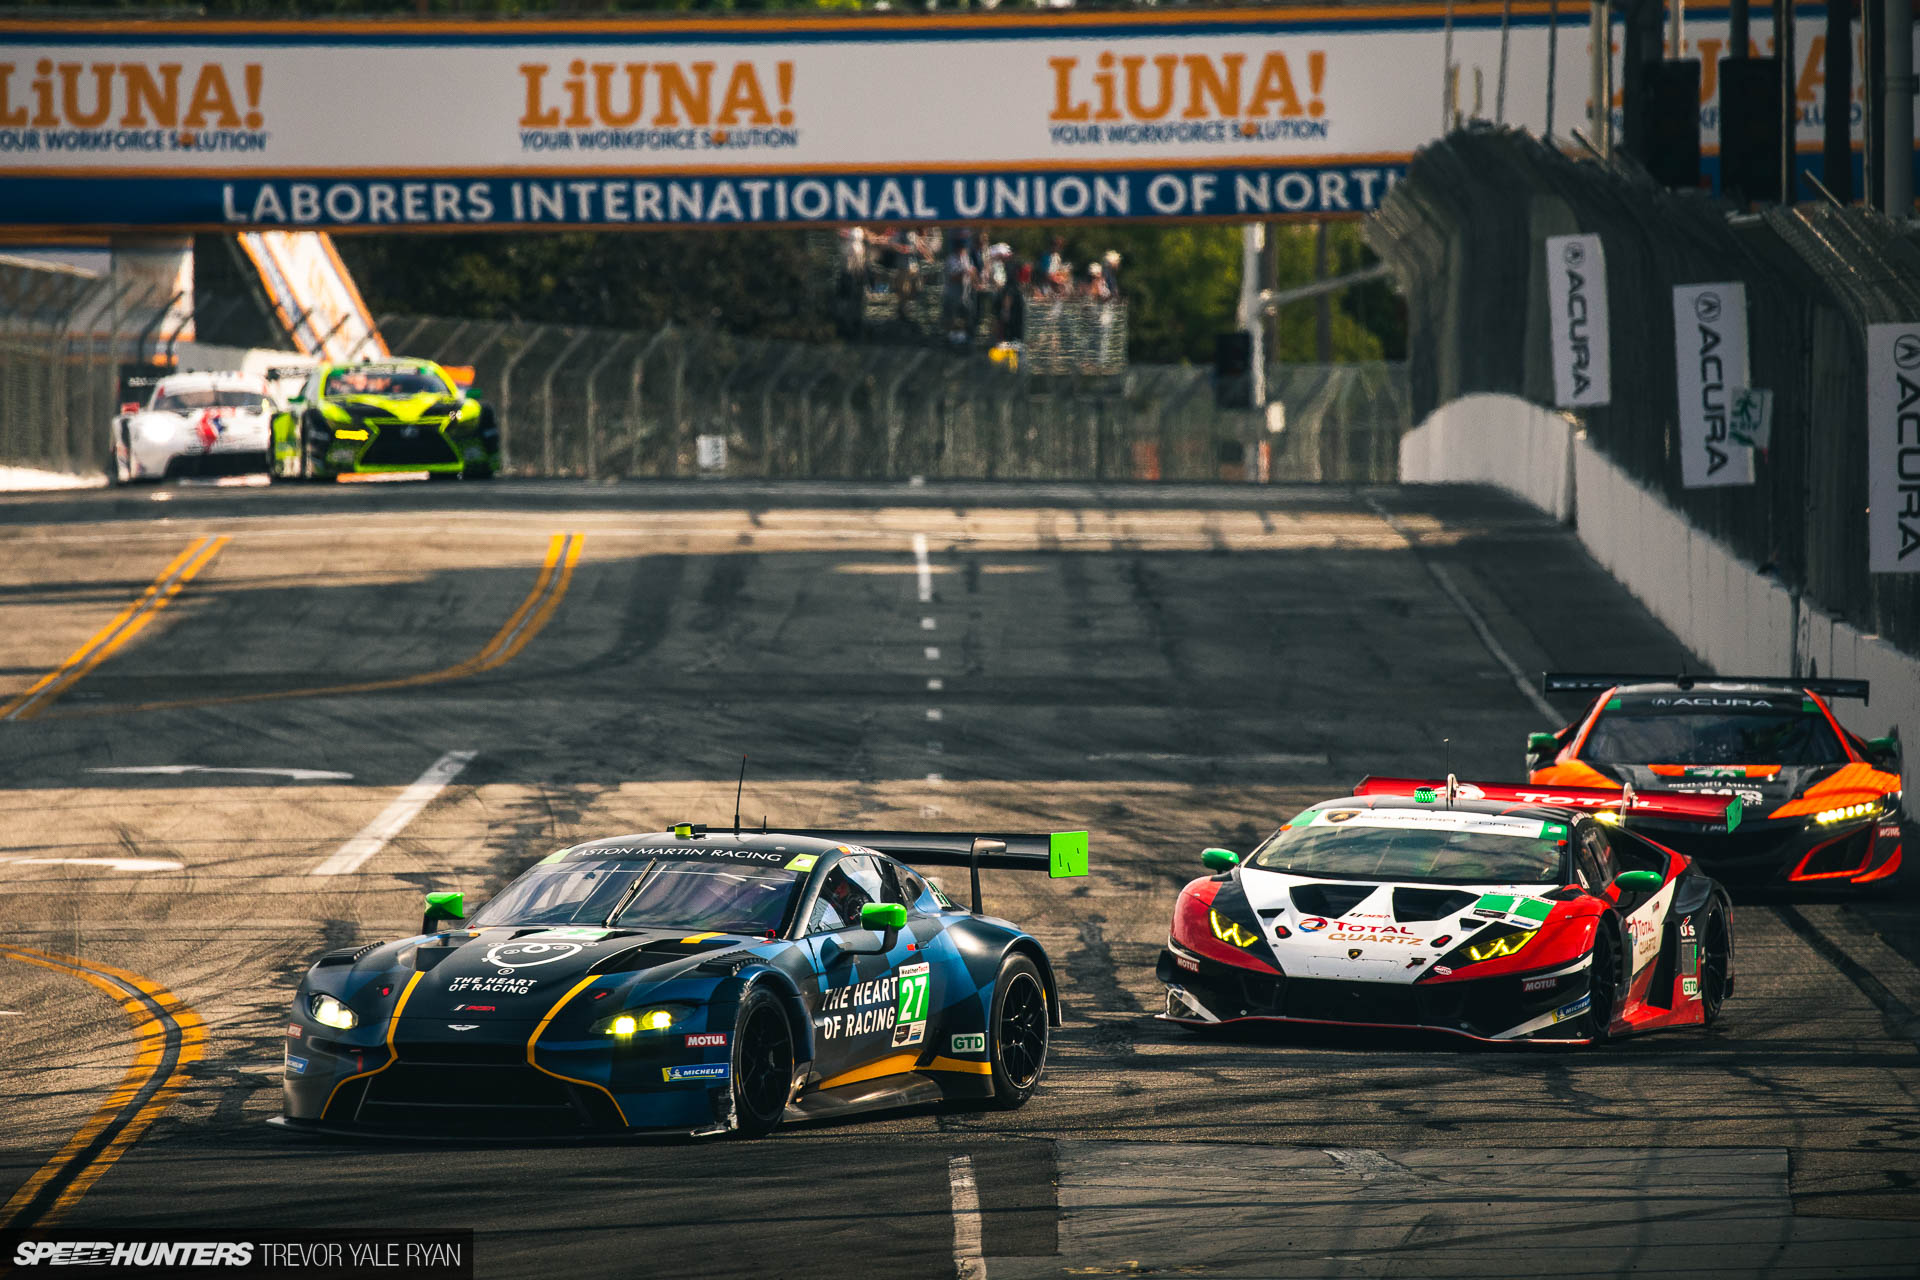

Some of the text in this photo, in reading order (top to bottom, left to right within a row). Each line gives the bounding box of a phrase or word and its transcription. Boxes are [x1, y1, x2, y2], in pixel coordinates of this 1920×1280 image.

[0, 58, 263, 129] LiUNA!
[518, 58, 795, 128] LiUNA!
[1048, 50, 1326, 121] LiUNA!
[0, 130, 41, 149] OUR
[46, 130, 165, 149] WORKFORCE
[520, 130, 572, 150] YOUR
[577, 130, 697, 149] WORKFORCE
[1050, 123, 1102, 144] YOUR
[1107, 121, 1226, 143] WORKFORCE
[222, 170, 1397, 222] LABORERS INTERNATIONAL UNION OF NORT
[1566, 269, 1590, 398] ACURA
[1698, 322, 1728, 477] ACURA
[1896, 372, 1920, 562] ACURA
[1673, 697, 1773, 708] ACURA
[574, 847, 784, 862] ASTON MARTIN RACING
[1333, 920, 1415, 935] TOTAL
[1327, 933, 1425, 946] QUARTZ
[1177, 957, 1199, 972] MOTUL
[448, 983, 530, 995] OF RACING
[452, 976, 538, 987] THE HEART
[1525, 978, 1557, 991] MOTUL
[1683, 980, 1697, 993] GTD
[821, 976, 899, 1012] THE HEART
[899, 975, 928, 1022] 27
[823, 1015, 842, 1040] OF
[844, 1006, 896, 1038] RACING
[687, 1035, 726, 1046] MOTUL
[953, 1035, 984, 1051] GTD
[682, 1068, 725, 1076] MICHELIN
